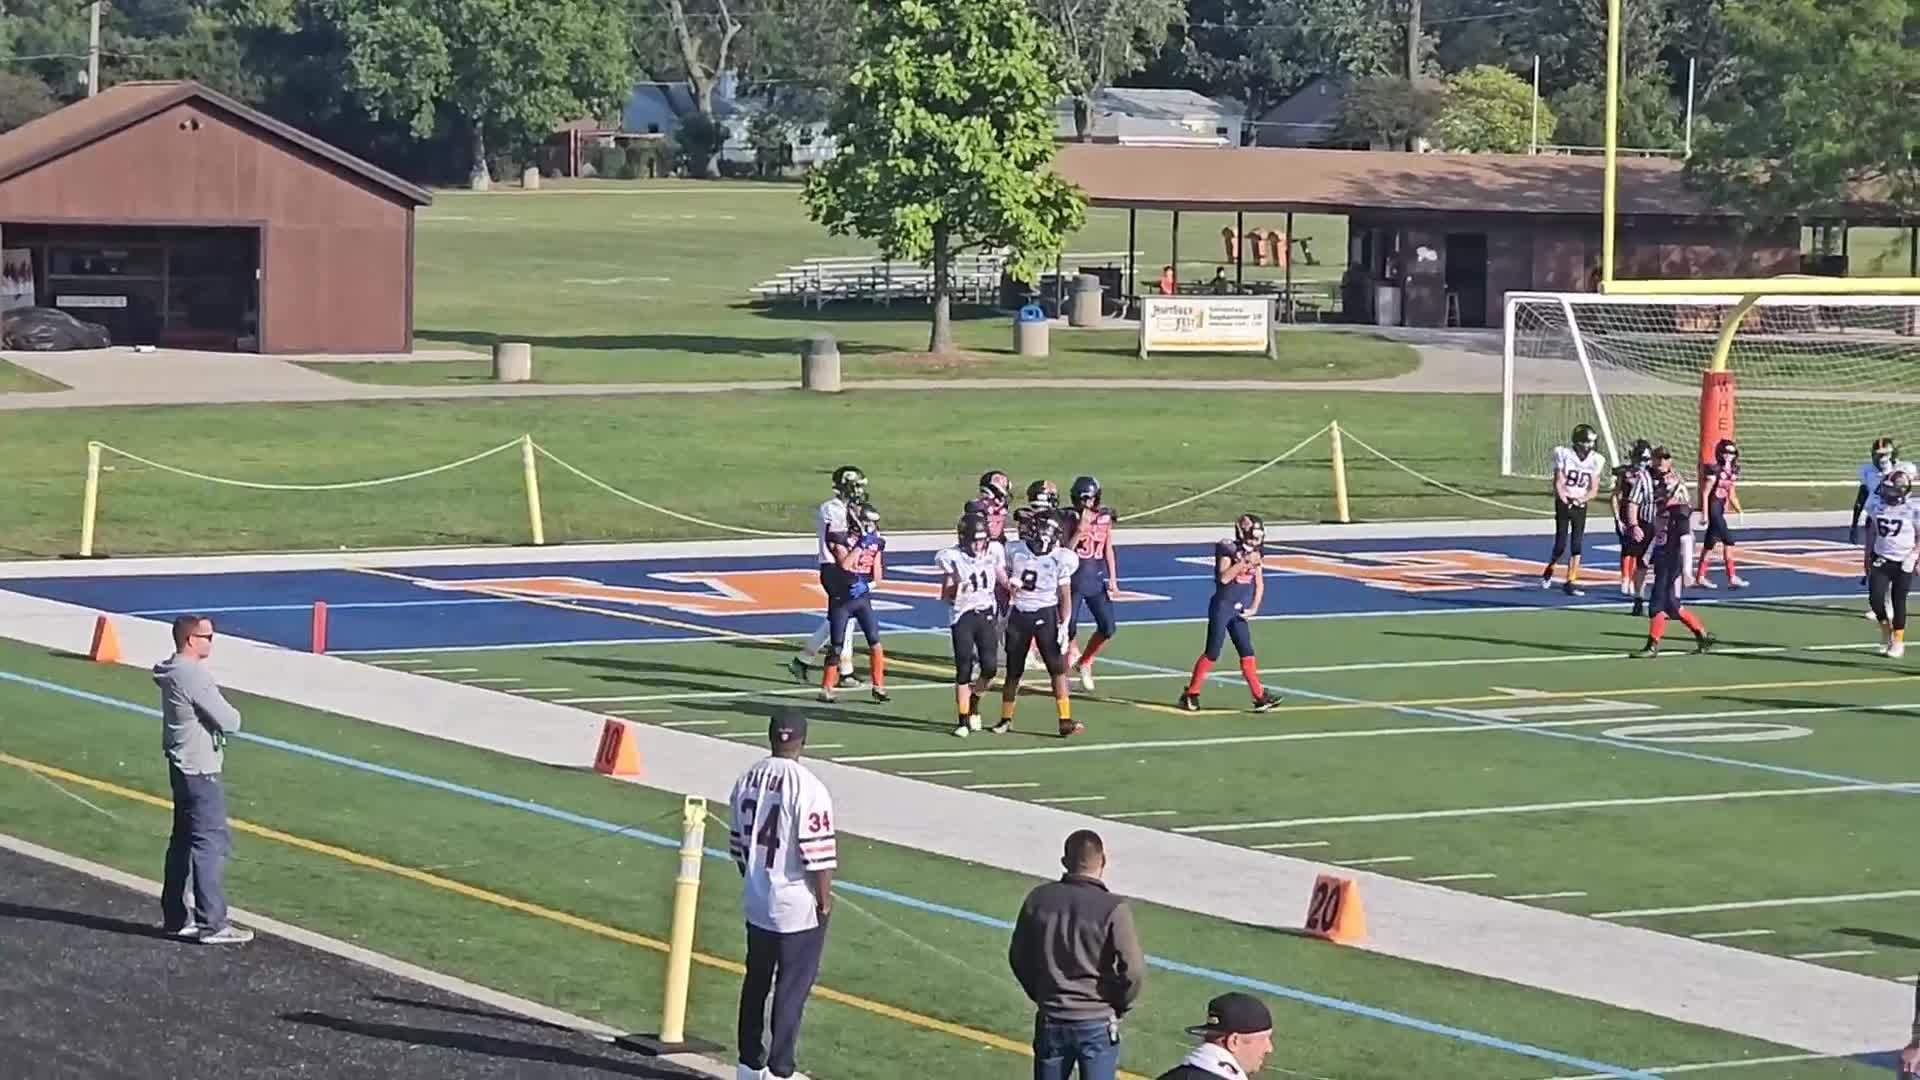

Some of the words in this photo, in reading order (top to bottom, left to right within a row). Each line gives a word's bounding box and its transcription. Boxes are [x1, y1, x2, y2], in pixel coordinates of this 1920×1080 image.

[1565, 469, 1593, 488] 80
[1877, 517, 1902, 538] 67
[1078, 532, 1107, 560] 37
[969, 569, 988, 592] 11
[808, 811, 831, 833] 34
[1307, 882, 1341, 932] 20
